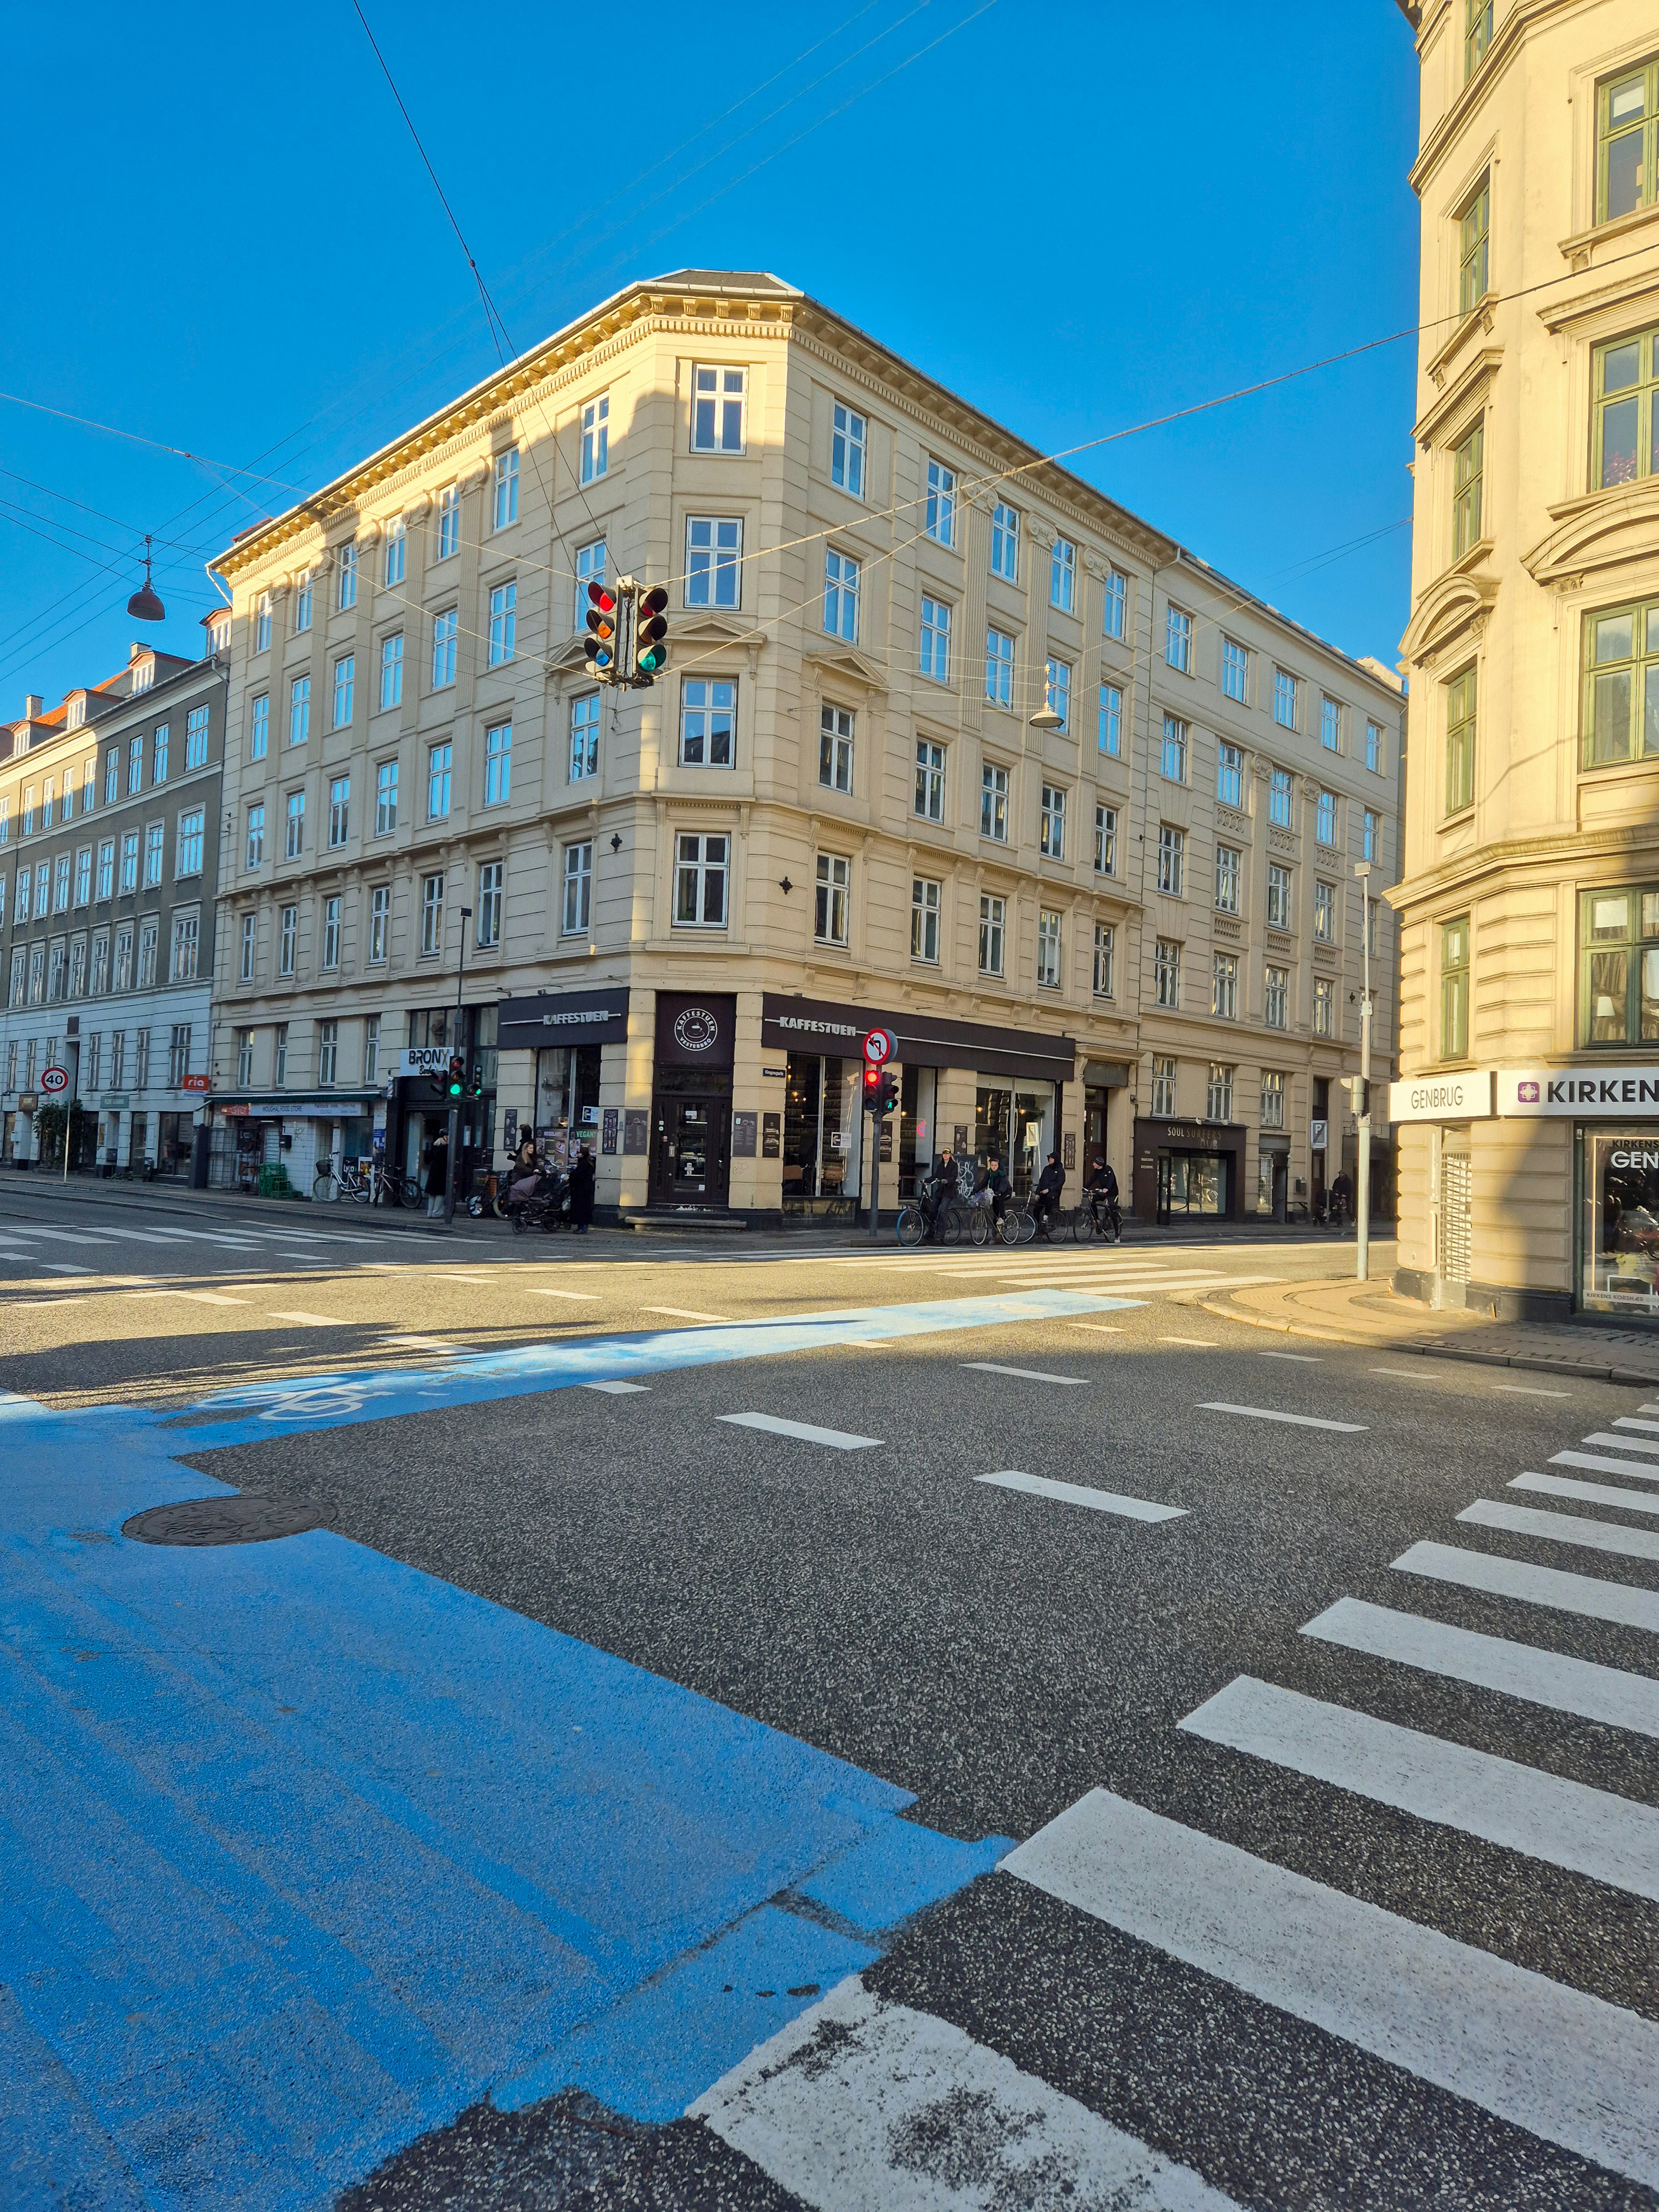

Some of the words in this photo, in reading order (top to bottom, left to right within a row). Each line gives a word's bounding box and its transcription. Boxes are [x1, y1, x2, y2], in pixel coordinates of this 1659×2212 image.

[543, 1010, 609, 1025] KAFFESTUEN
[677, 1011, 715, 1031] KAFFESTUEN
[780, 1016, 856, 1037] KAFFESTUEN
[680, 1037, 711, 1048] VESTERBRO
[409, 1049, 450, 1067] BRONX
[45, 1074, 64, 1085] 40
[188, 1076, 205, 1087] ria
[1411, 1086, 1463, 1109] GENBRUG
[1167, 1126, 1185, 1137] SOUL
[1186, 1128, 1222, 1140] SURFERS
[1315, 1124, 1322, 1134] P
[1611, 1151, 1658, 1169] GEN
